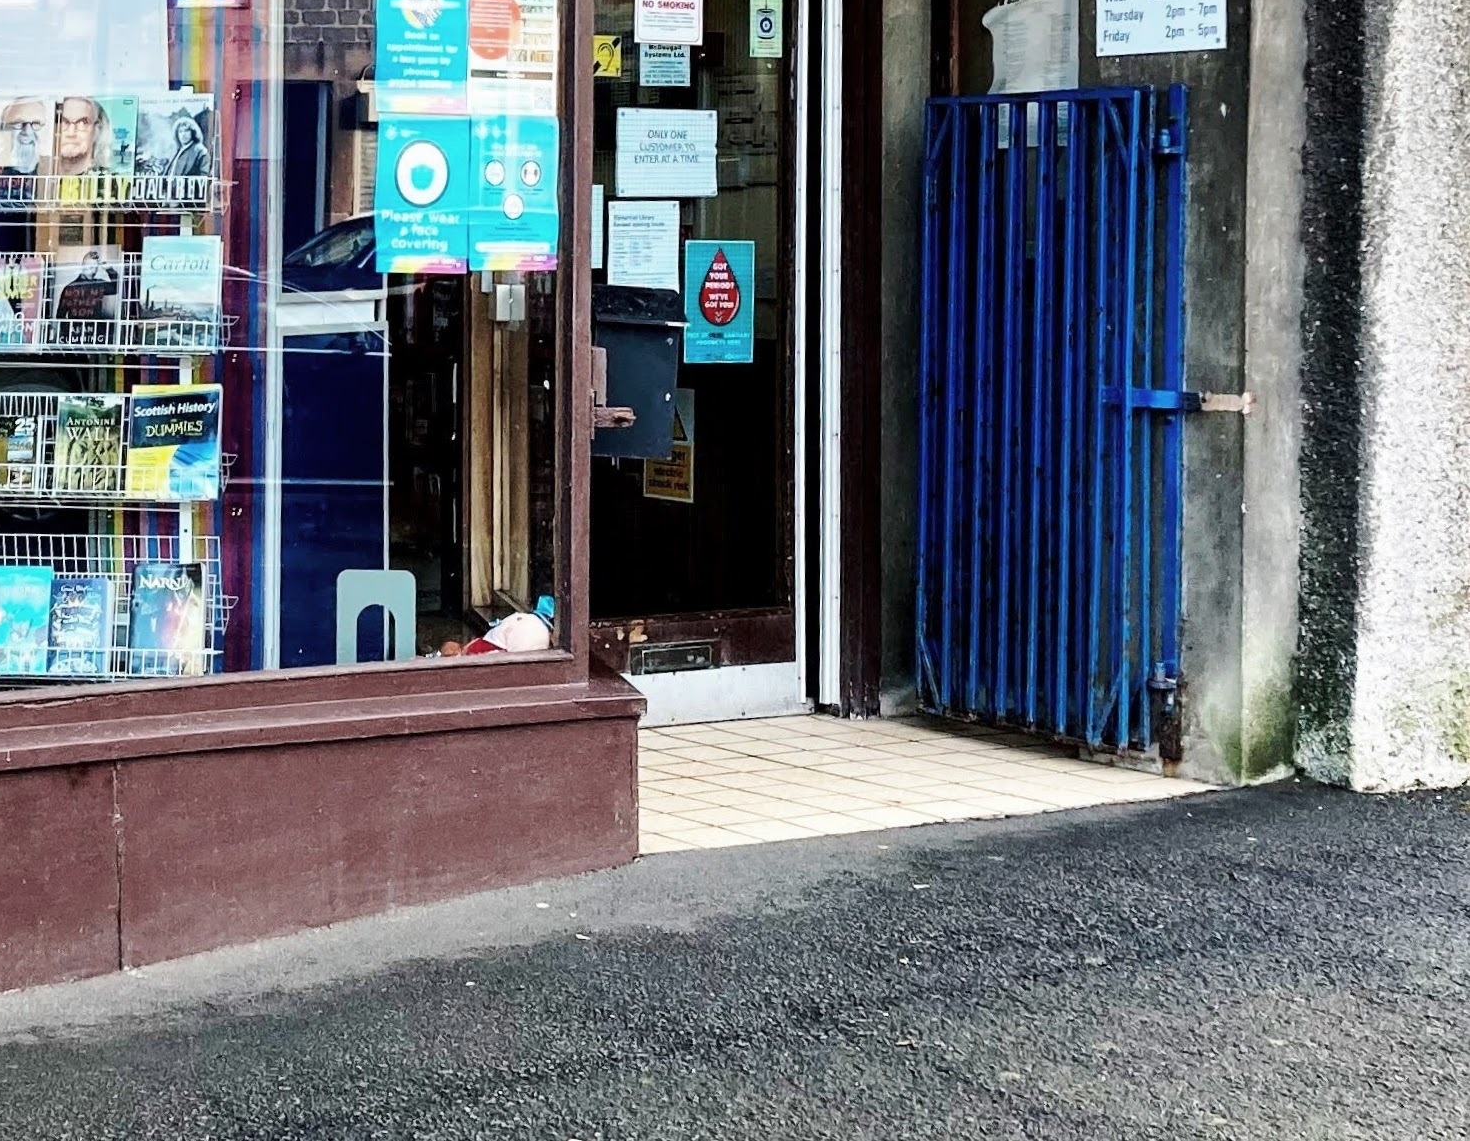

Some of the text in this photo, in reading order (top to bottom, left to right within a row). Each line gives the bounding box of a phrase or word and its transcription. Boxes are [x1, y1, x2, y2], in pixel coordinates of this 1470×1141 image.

[642, 0, 696, 10] NO SMOKING
[1104, 9, 1144, 23] Thursday
[1166, 5, 1186, 20] 2pm
[1198, 2, 1217, 17] 7pm
[1103, 29, 1130, 44] Friday
[1165, 25, 1185, 40] 2pm
[1197, 22, 1218, 38] 5pm
[647, 129, 688, 139] ONLY ONE
[634, 154, 700, 164] ENTER AT A TIME
[381, 209, 460, 224] Please wear
[411, 223, 439, 236] face
[391, 238, 448, 253] covering
[150, 255, 210, 271] Carron
[712, 263, 728, 271] GOT
[709, 272, 729, 281] YOUR
[134, 401, 216, 417] Scottish History
[14, 417, 35, 432] 25
[66, 416, 116, 426] ANTONINE
[145, 419, 204, 438] DUMMIES
[66, 426, 116, 442] WALL
